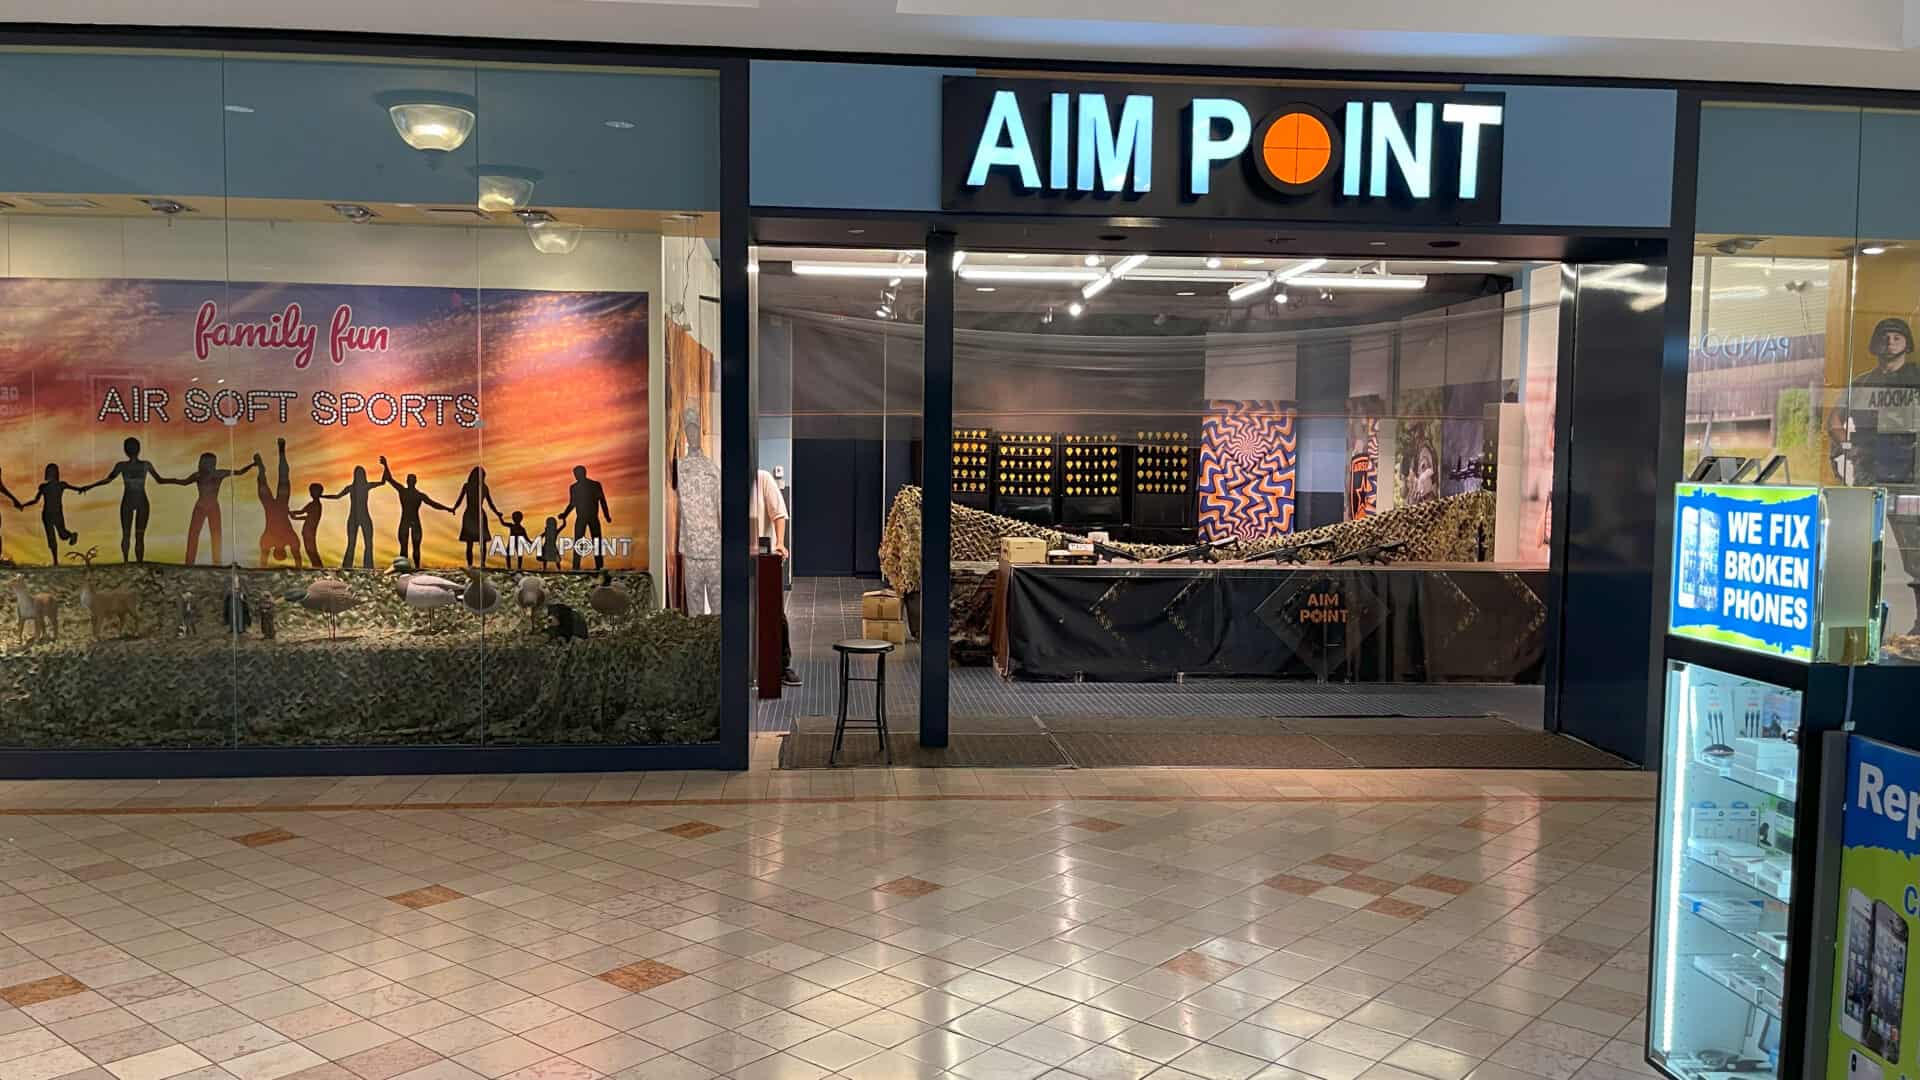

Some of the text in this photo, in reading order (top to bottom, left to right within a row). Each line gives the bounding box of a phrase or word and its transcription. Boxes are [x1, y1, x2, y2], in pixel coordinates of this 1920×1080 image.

[966, 90, 1503, 200] AIM POINT
[194, 301, 390, 369] family fun
[97, 385, 481, 428] AIR SOFT SPORTS
[489, 535, 631, 557] AIM POINT
[1727, 511, 1811, 549] WE FIX
[1724, 550, 1810, 590] BROKEN
[1300, 608, 1349, 624] POINT
[1307, 592, 1340, 607] AIM
[1722, 587, 1808, 631] PHONES
